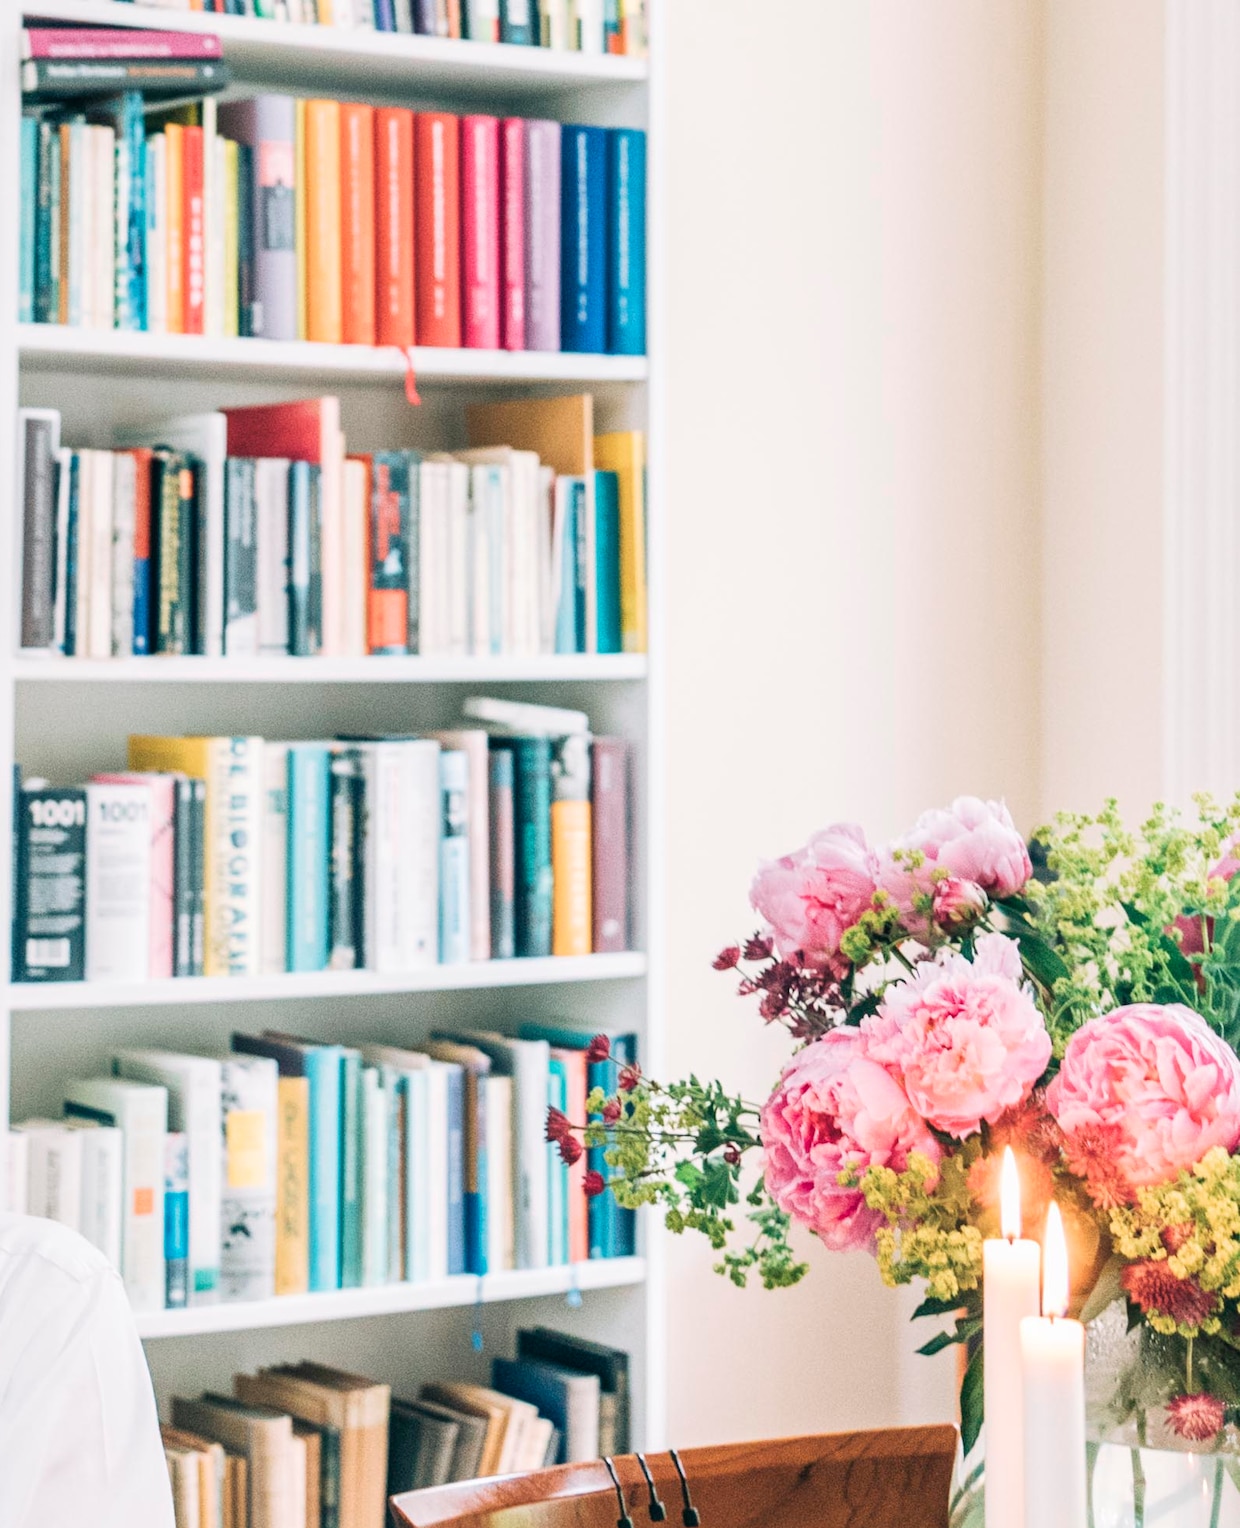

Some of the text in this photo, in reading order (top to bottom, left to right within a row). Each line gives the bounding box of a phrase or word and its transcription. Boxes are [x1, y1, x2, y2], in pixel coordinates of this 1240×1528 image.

[229, 737, 249, 777] DE
[30, 799, 85, 827] 1001
[99, 802, 148, 822] 1001
